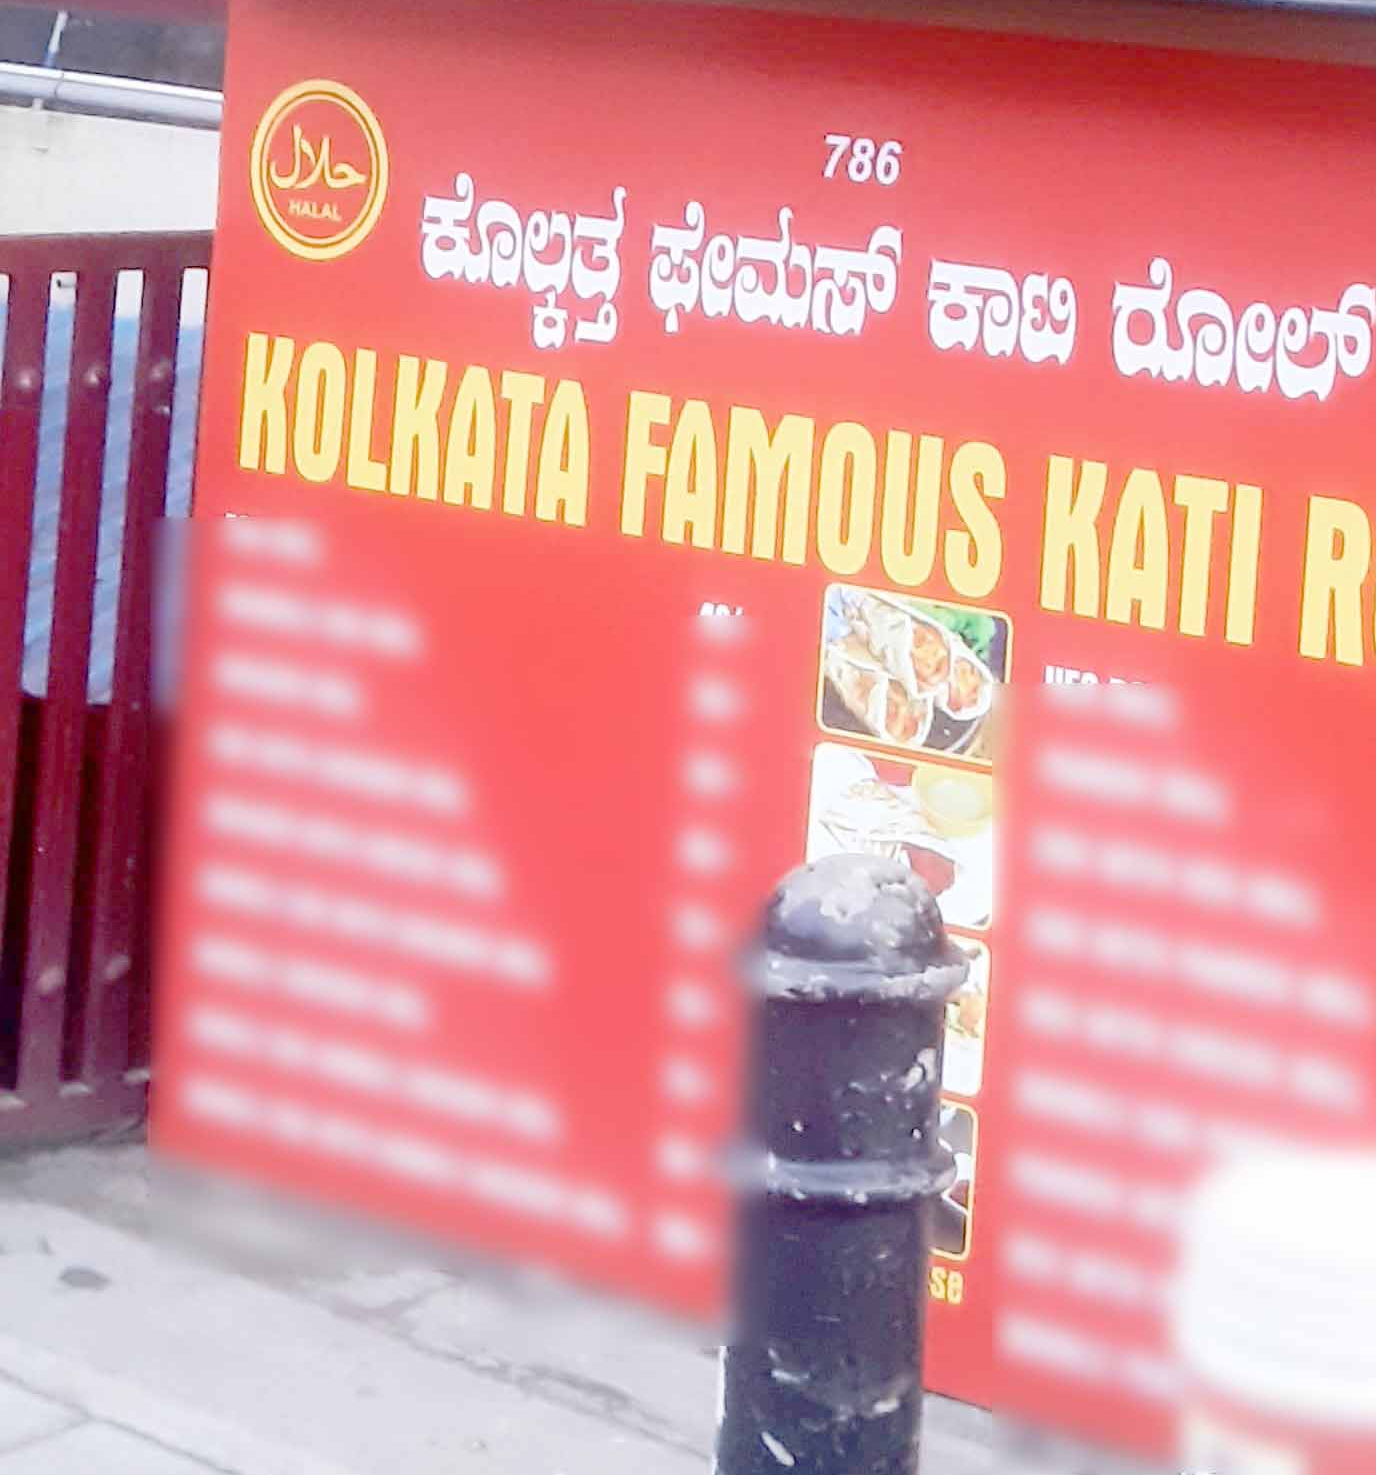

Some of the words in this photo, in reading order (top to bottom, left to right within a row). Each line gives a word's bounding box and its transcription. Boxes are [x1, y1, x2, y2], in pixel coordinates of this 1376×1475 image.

[270, 124, 367, 189] حلال
[823, 133, 902, 186] 786
[288, 199, 343, 223] HALAL
[649, 201, 903, 336] ಫೇಮಸ್
[927, 258, 1078, 364] ಕಾಟಿ
[240, 331, 590, 527] KOLKATA
[619, 390, 1006, 599] FAMOUS
[1039, 454, 1263, 646] KATI
